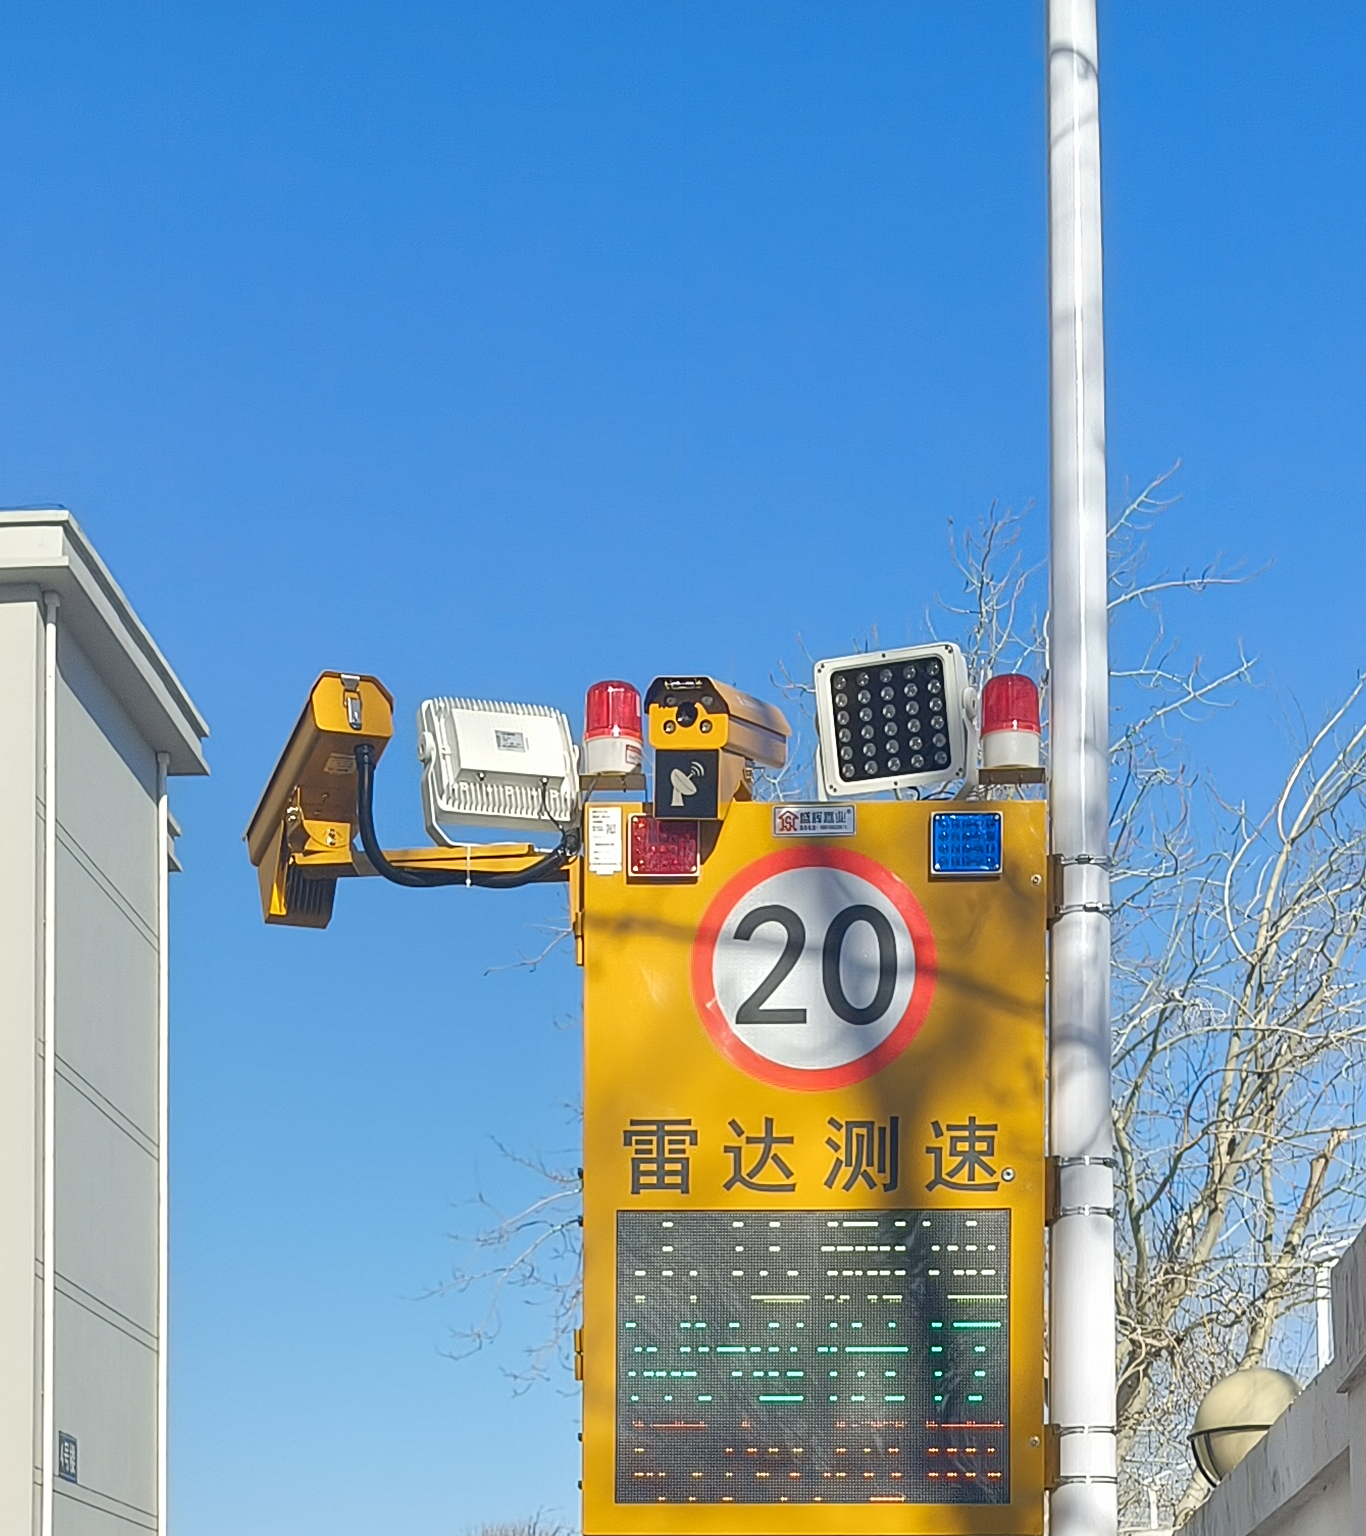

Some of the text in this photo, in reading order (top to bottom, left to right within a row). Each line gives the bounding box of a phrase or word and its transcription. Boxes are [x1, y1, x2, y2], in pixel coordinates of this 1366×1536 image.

[732, 903, 899, 1027] 20
[622, 1115, 1000, 1195] 雷达测速
